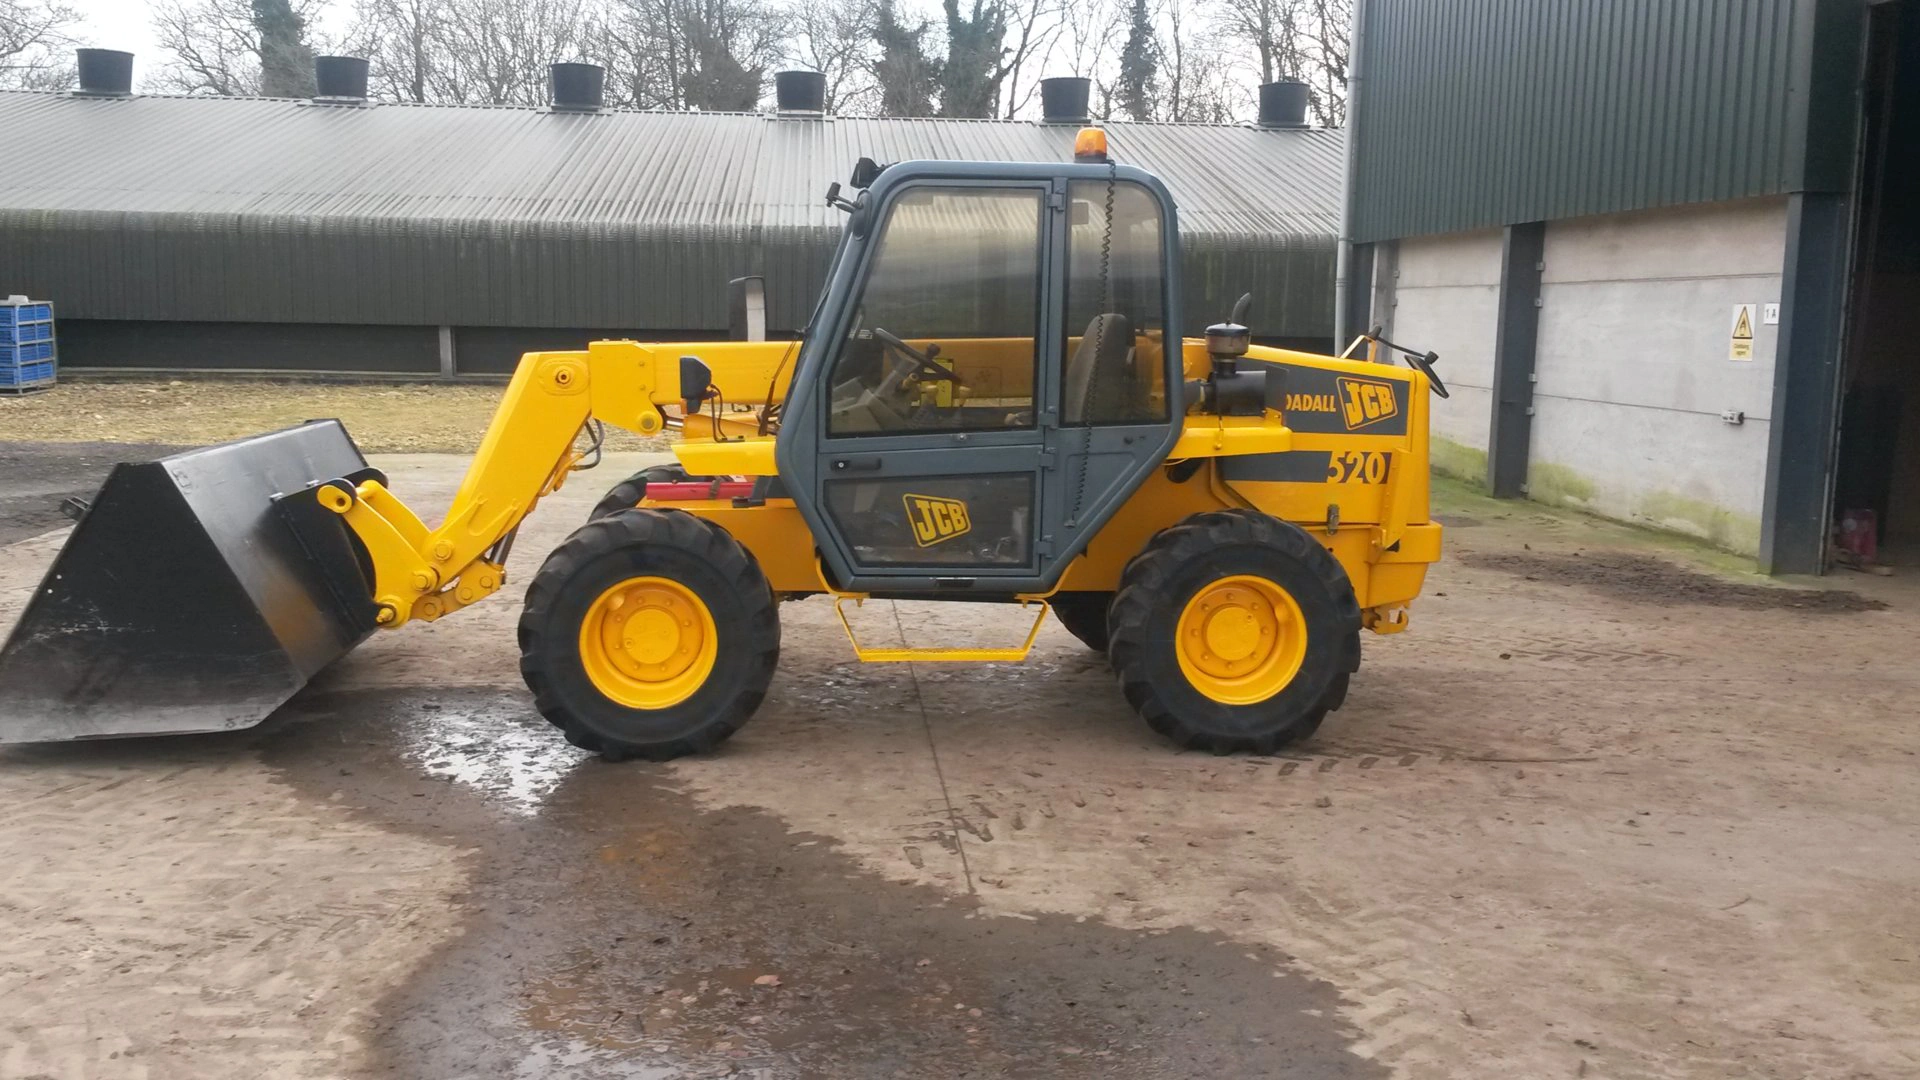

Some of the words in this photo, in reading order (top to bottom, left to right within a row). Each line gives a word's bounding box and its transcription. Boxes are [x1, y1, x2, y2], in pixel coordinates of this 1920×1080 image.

[1344, 381, 1394, 426] JCB
[1328, 451, 1386, 483] 520
[915, 499, 966, 542] JCB
